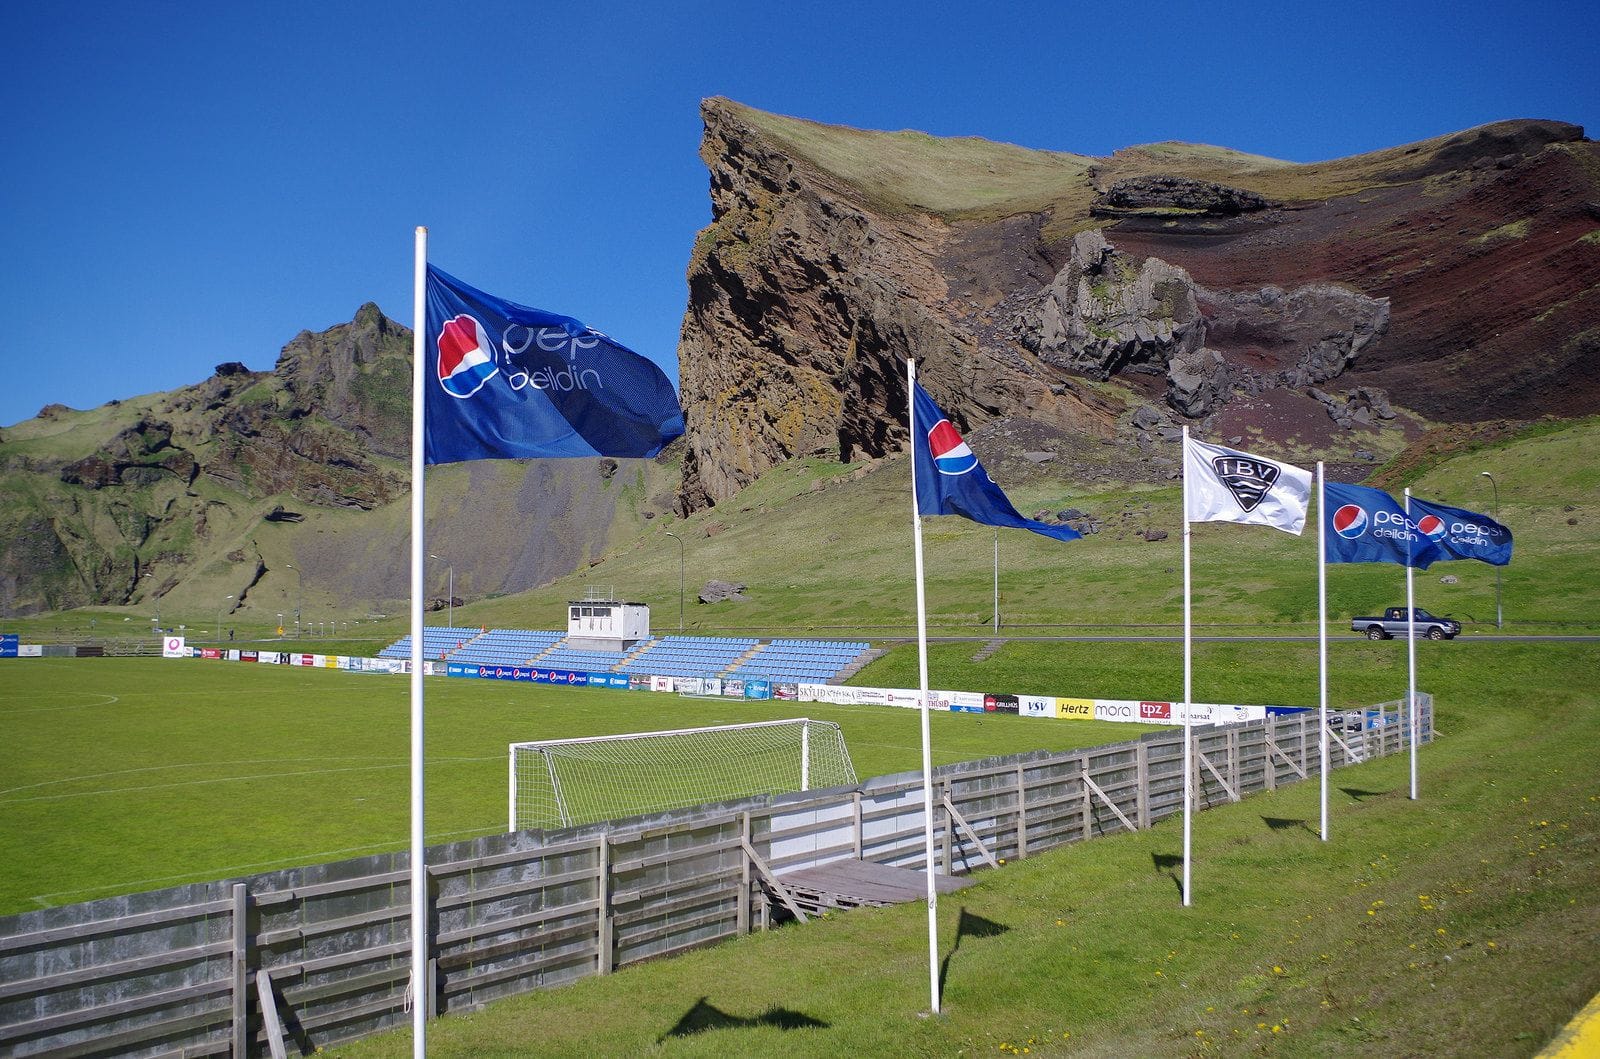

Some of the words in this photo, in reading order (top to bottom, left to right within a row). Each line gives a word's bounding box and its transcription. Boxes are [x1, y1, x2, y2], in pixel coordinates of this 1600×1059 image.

[1374, 528, 1418, 542] deildin
[1451, 522, 1503, 537] pepsi
[1028, 701, 1048, 712] VSV
[1060, 704, 1090, 714] Hertz
[1095, 705, 1132, 717] mora
[1142, 704, 1162, 718] tpz
